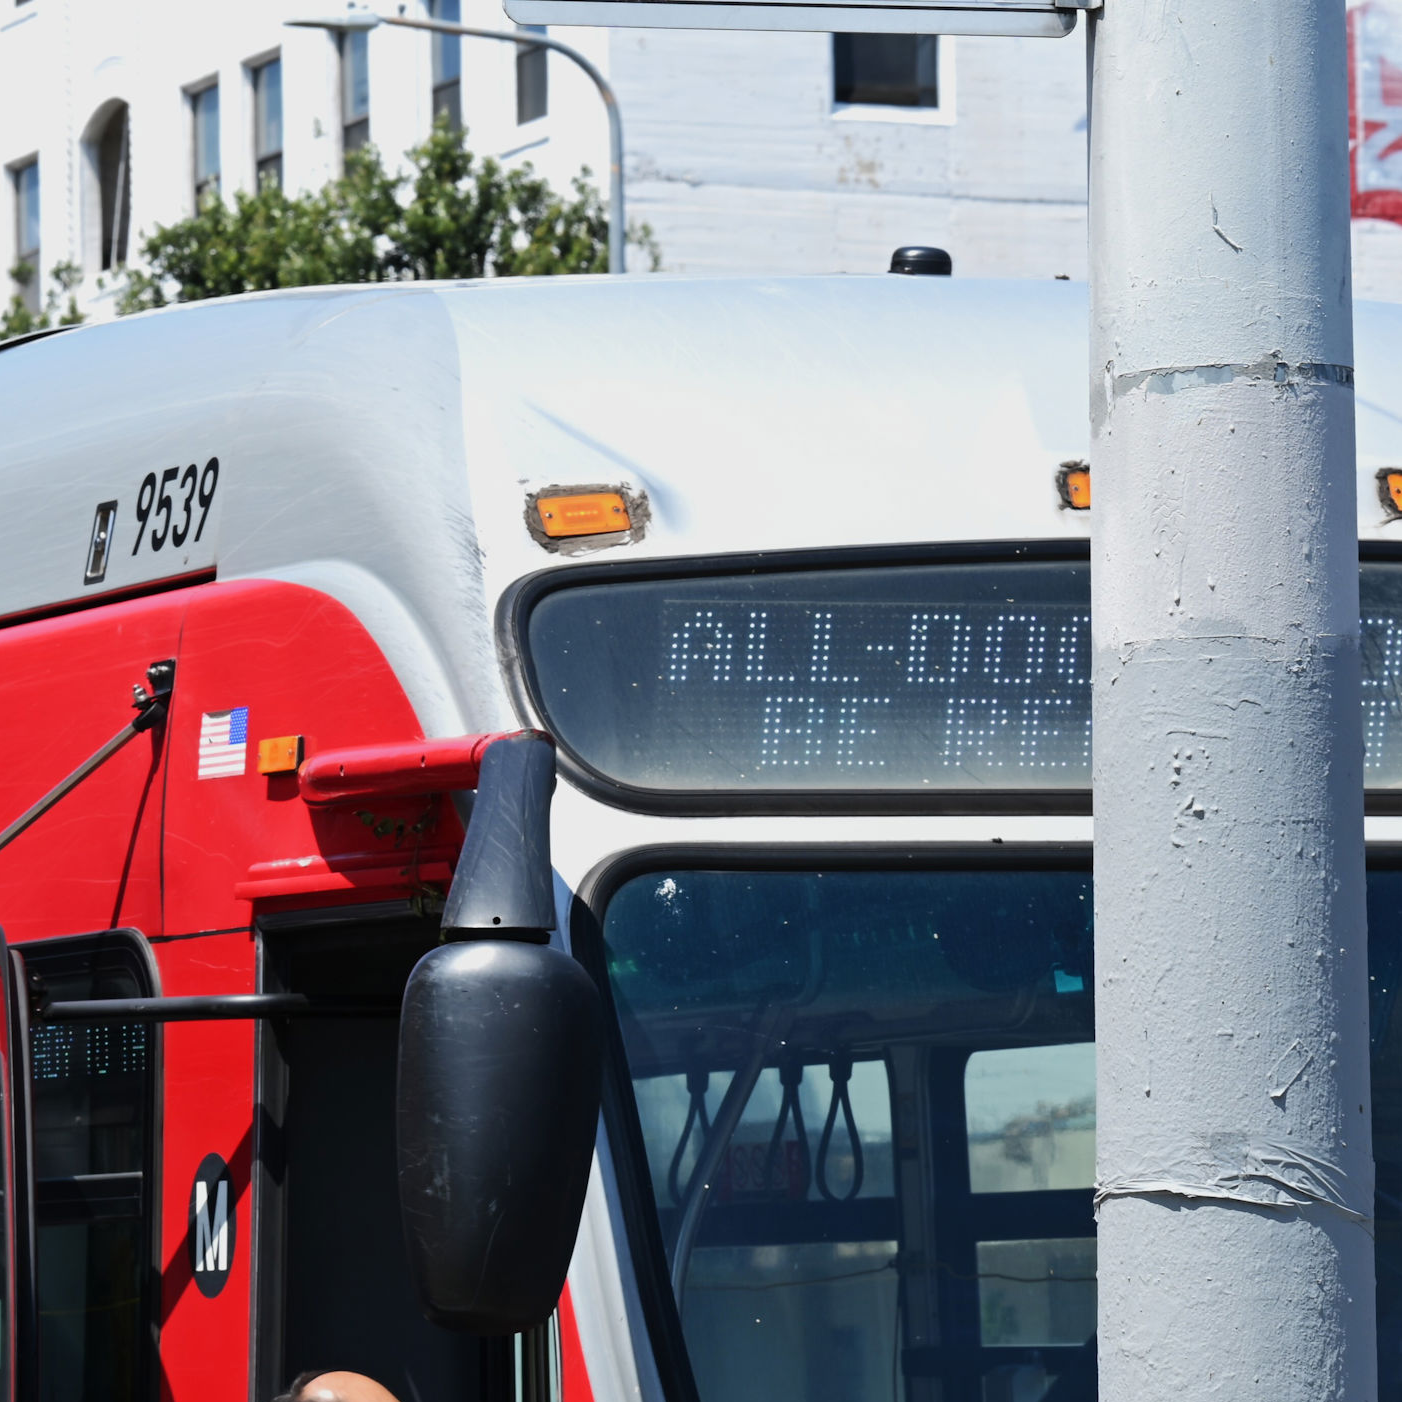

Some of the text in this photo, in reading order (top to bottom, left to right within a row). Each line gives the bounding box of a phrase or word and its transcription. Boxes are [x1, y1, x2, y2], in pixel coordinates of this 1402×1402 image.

[132, 457, 219, 556] 9539
[761, 698, 1091, 767] BE RE
[195, 1179, 229, 1272] M
